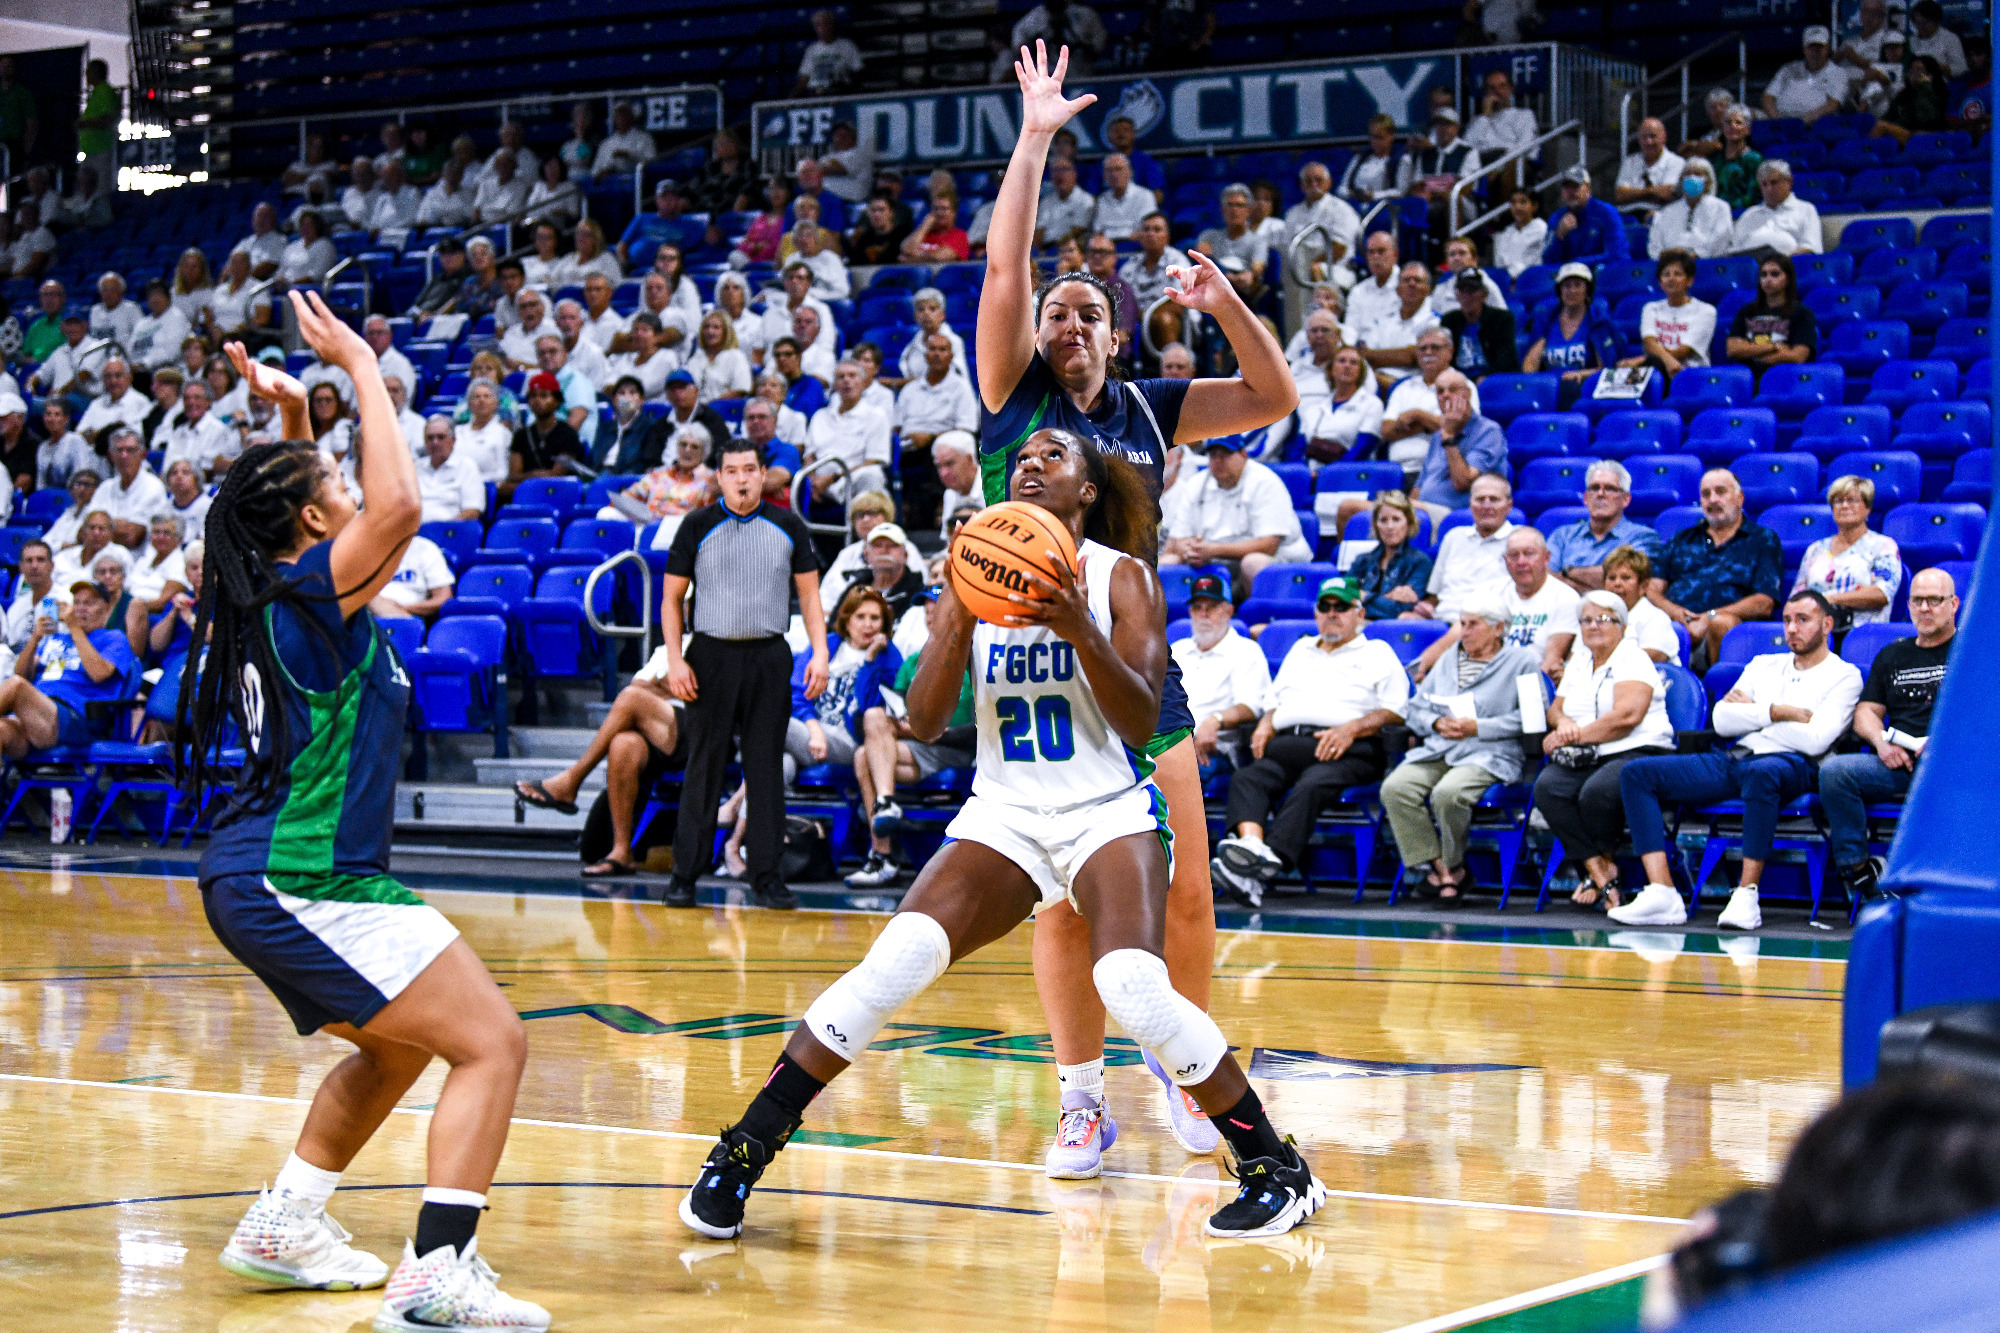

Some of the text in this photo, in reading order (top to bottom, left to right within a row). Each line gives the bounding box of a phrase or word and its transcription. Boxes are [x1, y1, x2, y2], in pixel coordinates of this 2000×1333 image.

[1511, 56, 1539, 85] FF
[646, 95, 688, 129] EE
[1171, 62, 1435, 141] CITY
[788, 107, 836, 146] FF
[960, 544, 1029, 595] Wilson
[986, 640, 1075, 684] FGCU
[995, 694, 1076, 762] 20
